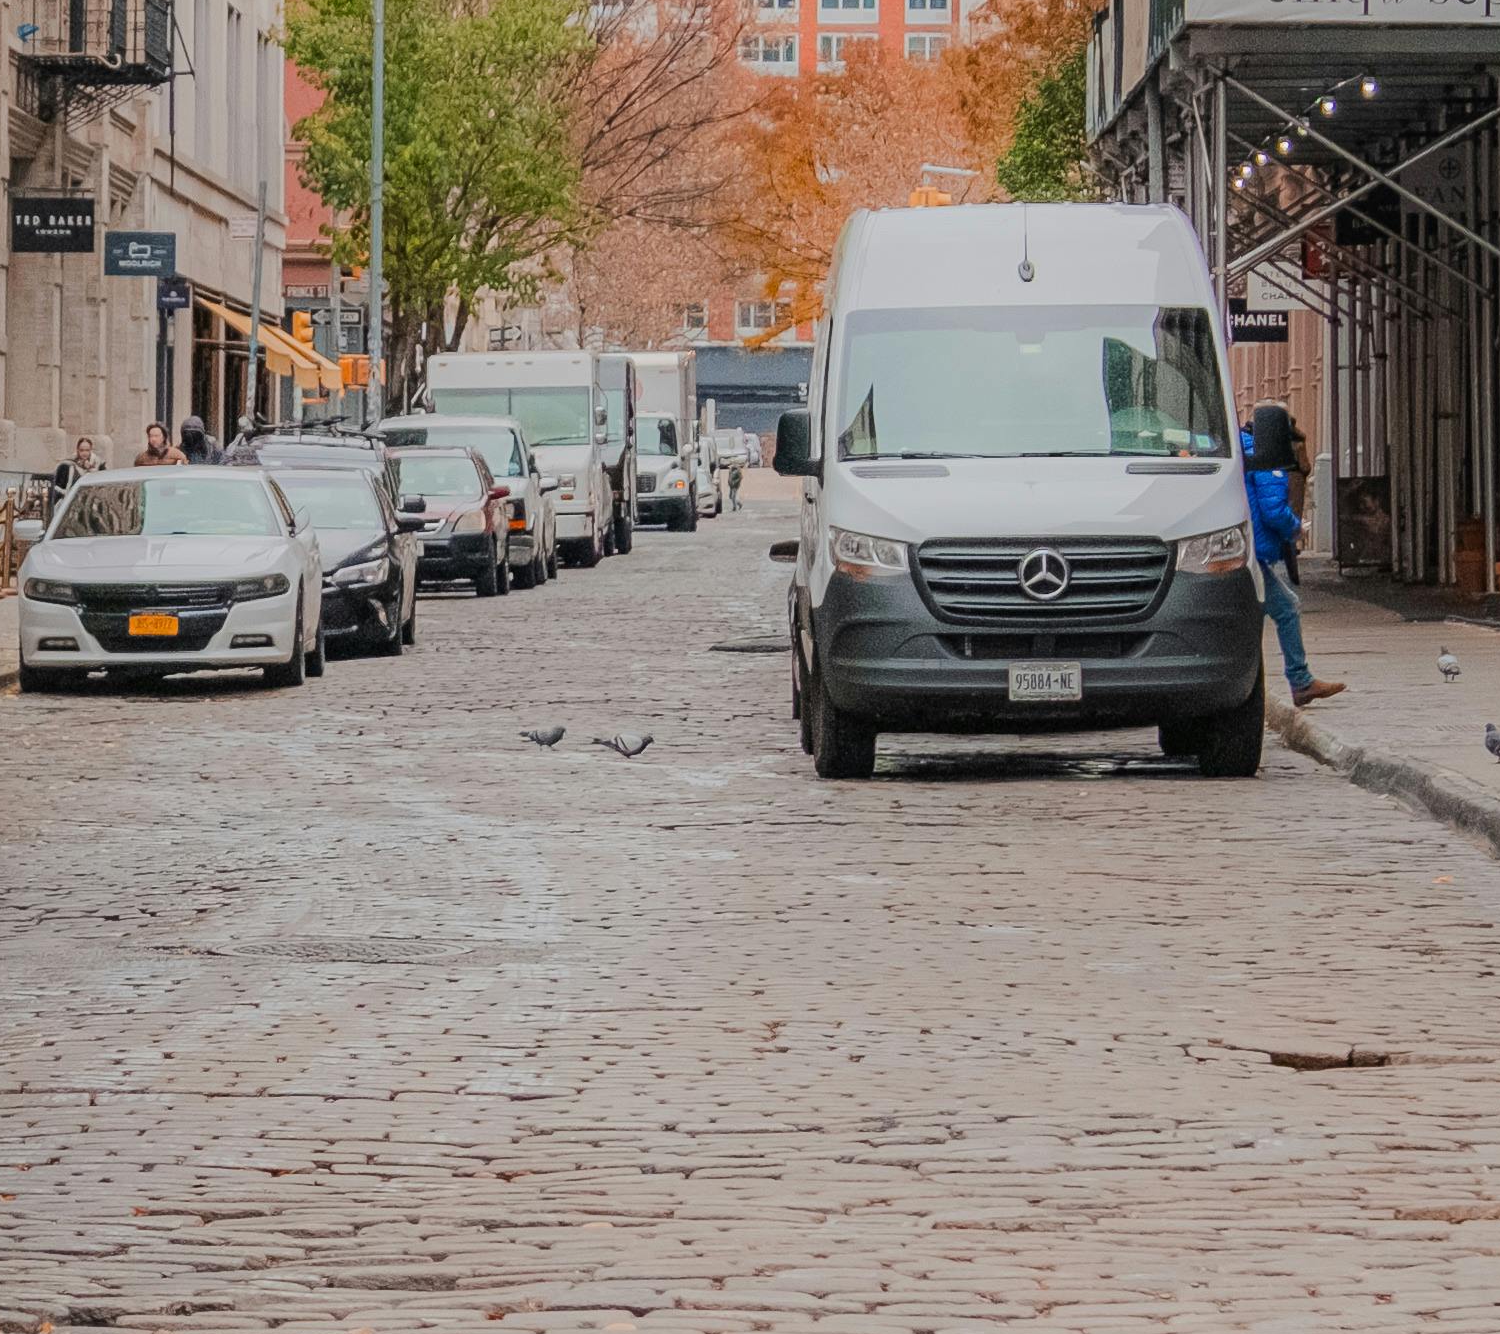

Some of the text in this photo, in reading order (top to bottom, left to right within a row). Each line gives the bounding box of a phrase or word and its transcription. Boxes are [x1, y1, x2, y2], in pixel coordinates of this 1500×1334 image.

[1415, 186, 1467, 204] FAN
[15, 214, 93, 227] TED BAKER
